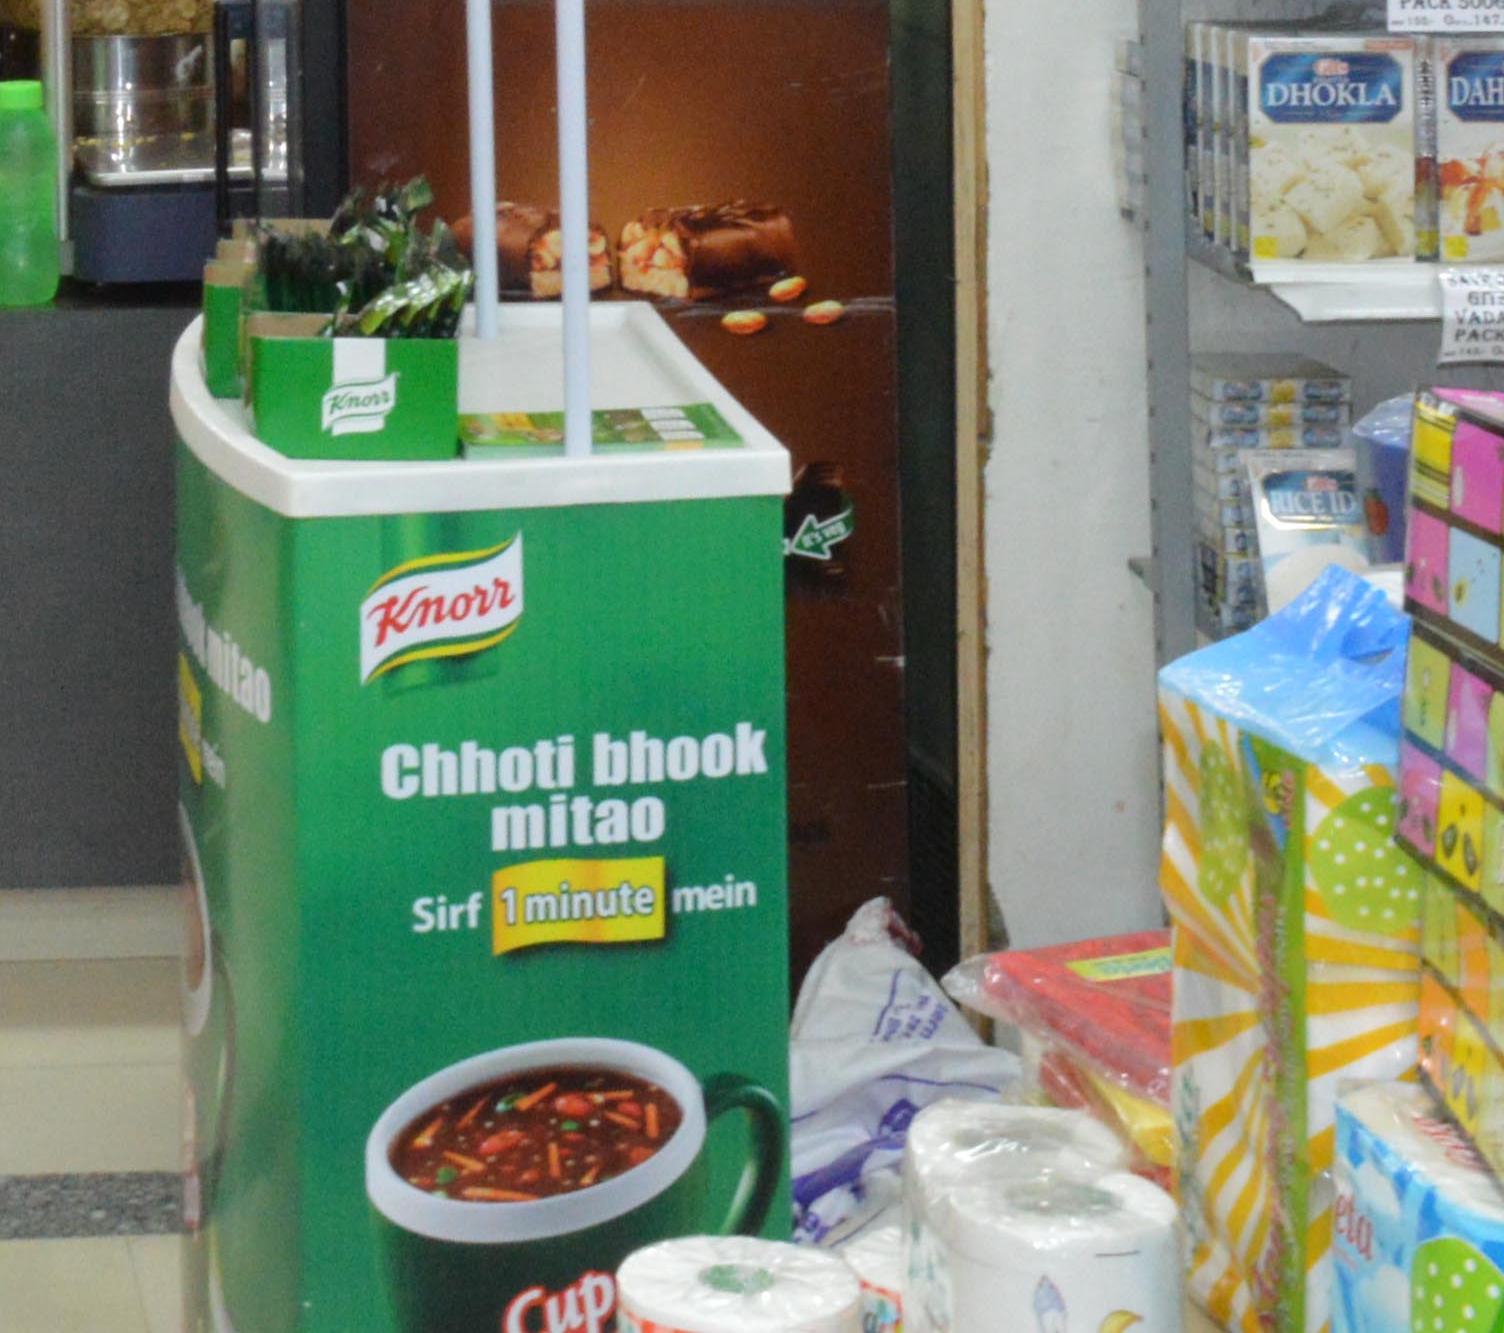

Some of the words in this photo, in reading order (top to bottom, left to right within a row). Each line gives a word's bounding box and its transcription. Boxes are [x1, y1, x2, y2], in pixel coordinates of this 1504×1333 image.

[1266, 81, 1395, 107] DHOKLA
[328, 385, 391, 415] Knorr
[366, 575, 518, 648] Knorr
[380, 735, 575, 800] Chhoti
[593, 722, 768, 788] bhook
[491, 794, 666, 852] mitao
[411, 893, 483, 934] Sirf
[500, 889, 520, 925] 1
[524, 883, 656, 925] minute
[672, 874, 758, 914] mein
